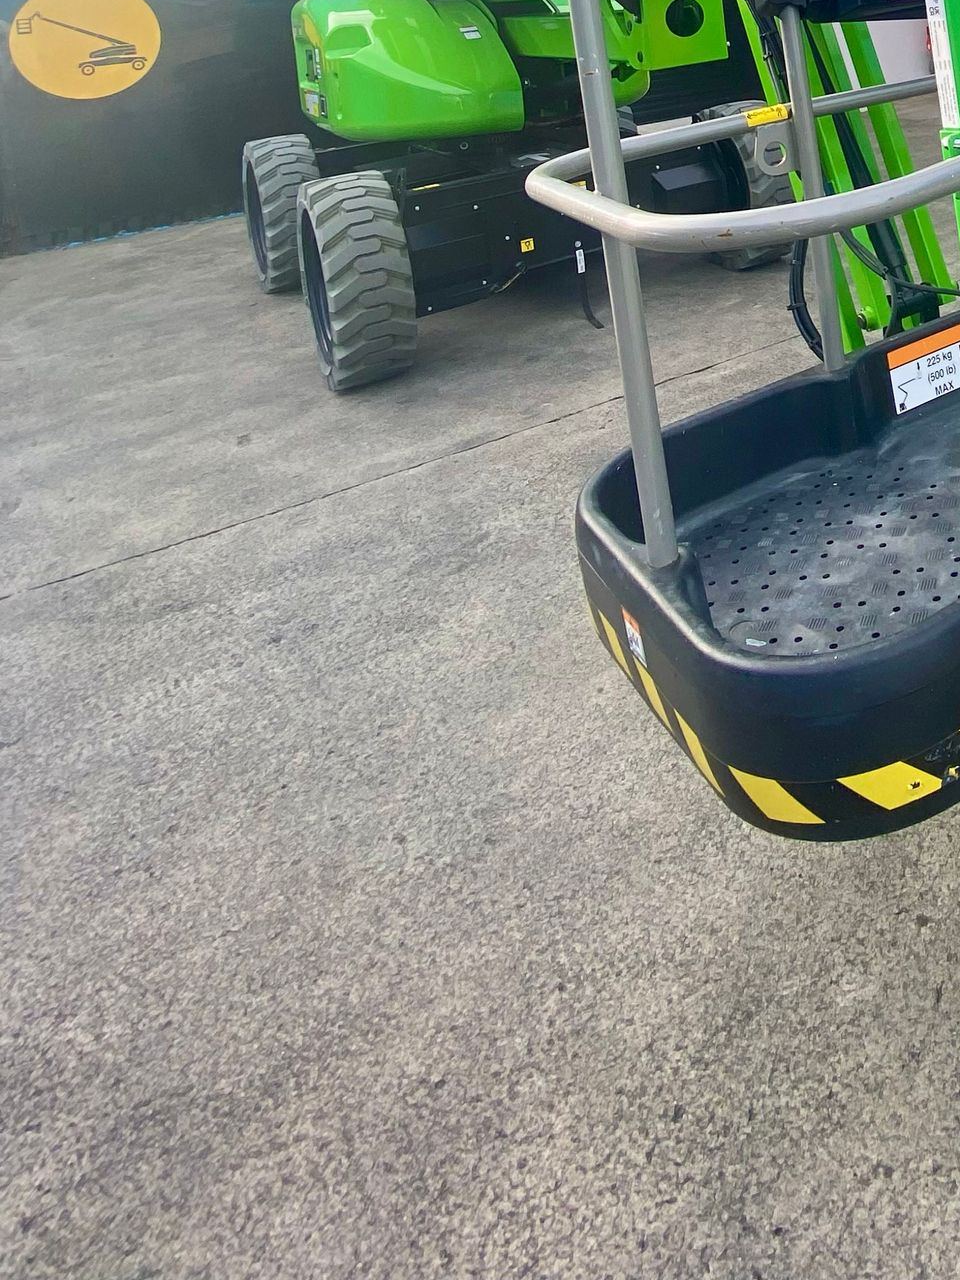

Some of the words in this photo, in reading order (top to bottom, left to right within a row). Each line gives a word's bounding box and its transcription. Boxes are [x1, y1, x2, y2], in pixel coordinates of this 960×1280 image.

[926, 354, 941, 367] 225
[942, 351, 953, 361] kg
[928, 368, 944, 385] (500
[946, 363, 957, 375] lb)
[935, 380, 954, 396] MAX
